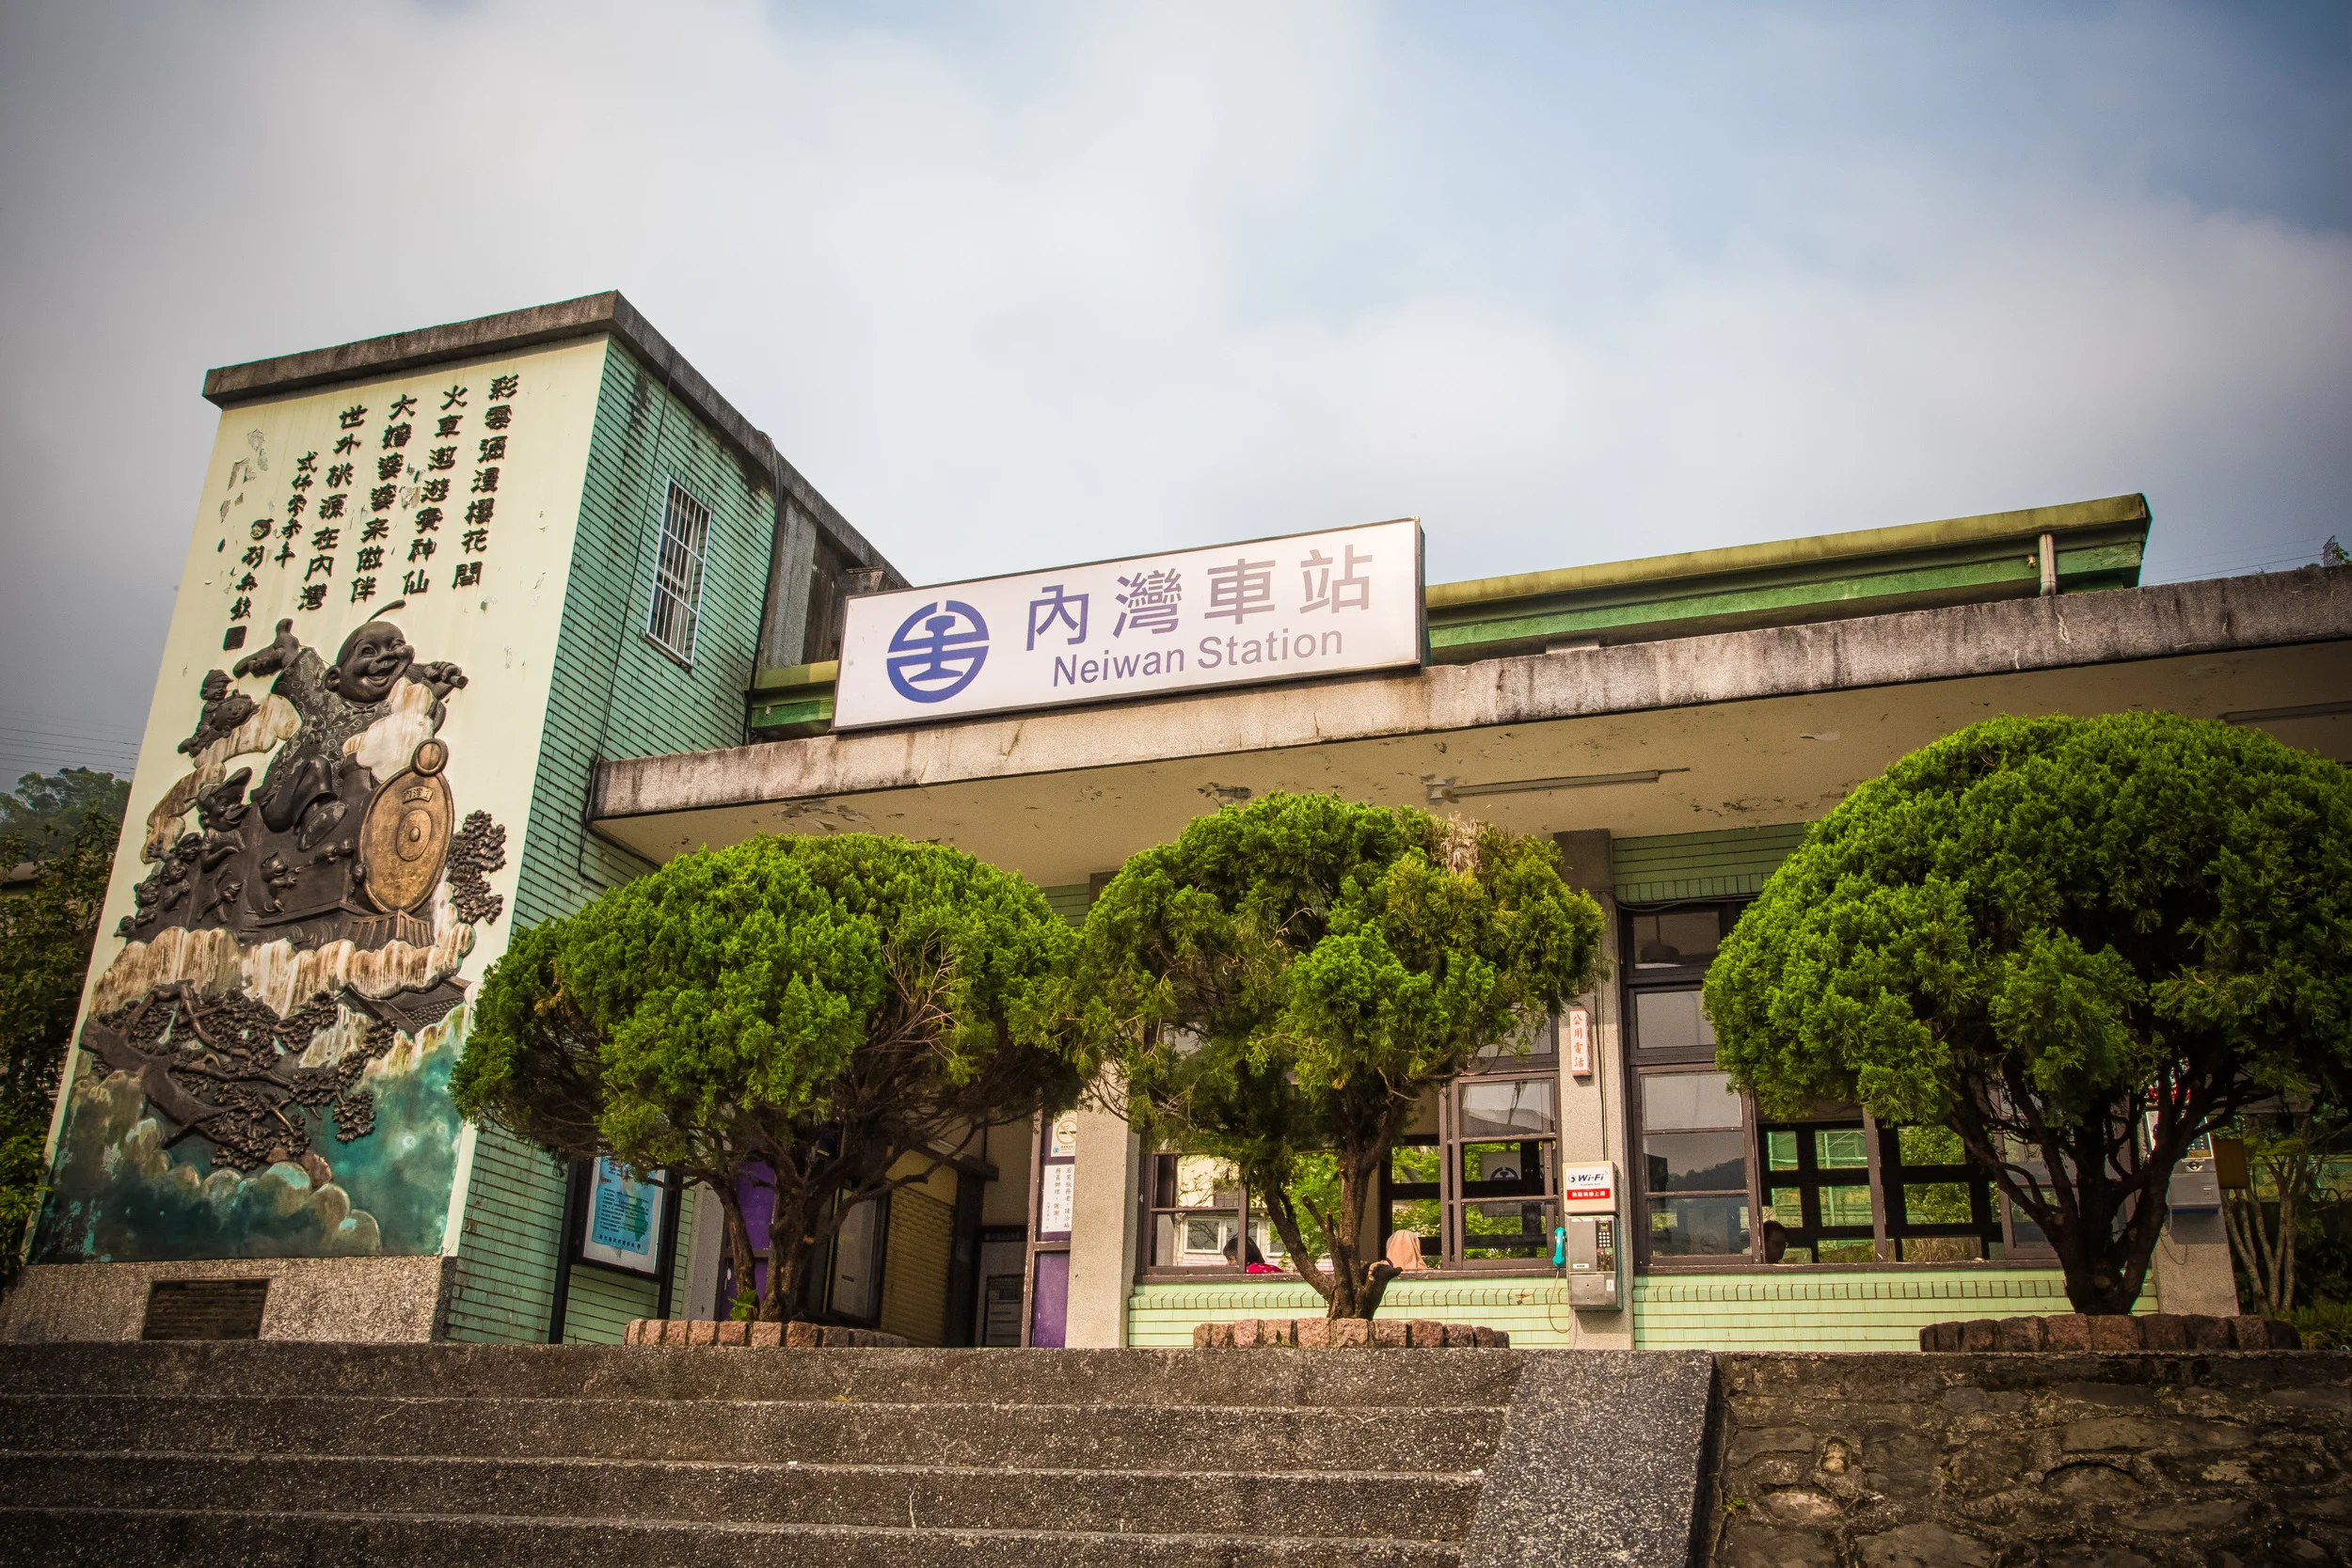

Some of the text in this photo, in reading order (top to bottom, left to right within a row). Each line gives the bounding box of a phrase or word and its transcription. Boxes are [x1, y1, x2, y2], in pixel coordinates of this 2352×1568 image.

[1025, 544, 1374, 652] 內灣車站
[1053, 625, 1343, 689] Neiwan Station
[1572, 1013, 1584, 1068] 公用電話
[1578, 1173, 1604, 1182] Wi-Fi
